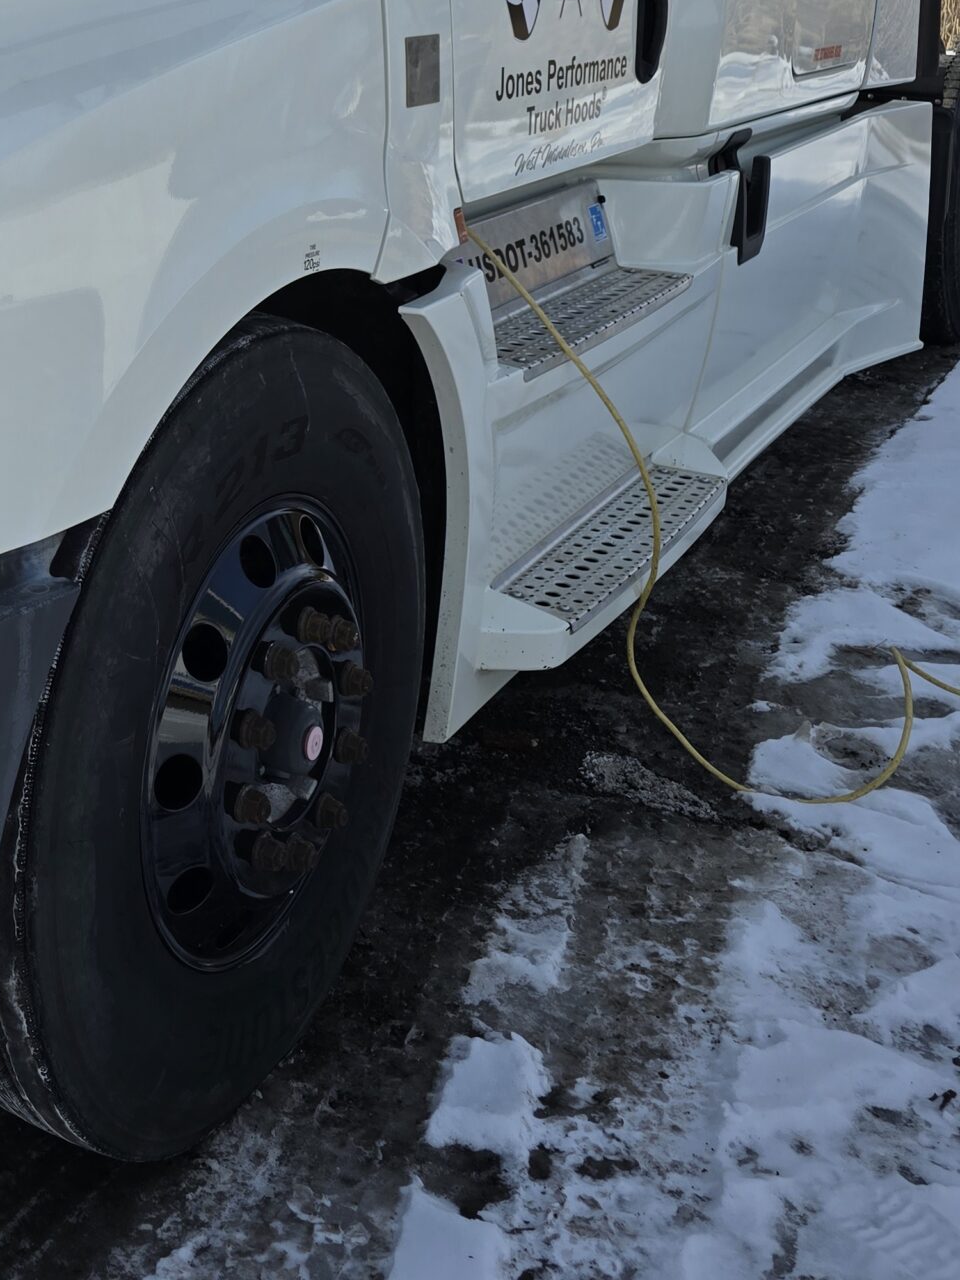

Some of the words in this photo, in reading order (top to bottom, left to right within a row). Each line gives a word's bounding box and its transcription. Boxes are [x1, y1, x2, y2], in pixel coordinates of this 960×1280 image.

[496, 66, 542, 101] Jones
[547, 55, 627, 92] Performance
[527, 101, 561, 135] Truck
[514, 148, 543, 176] West
